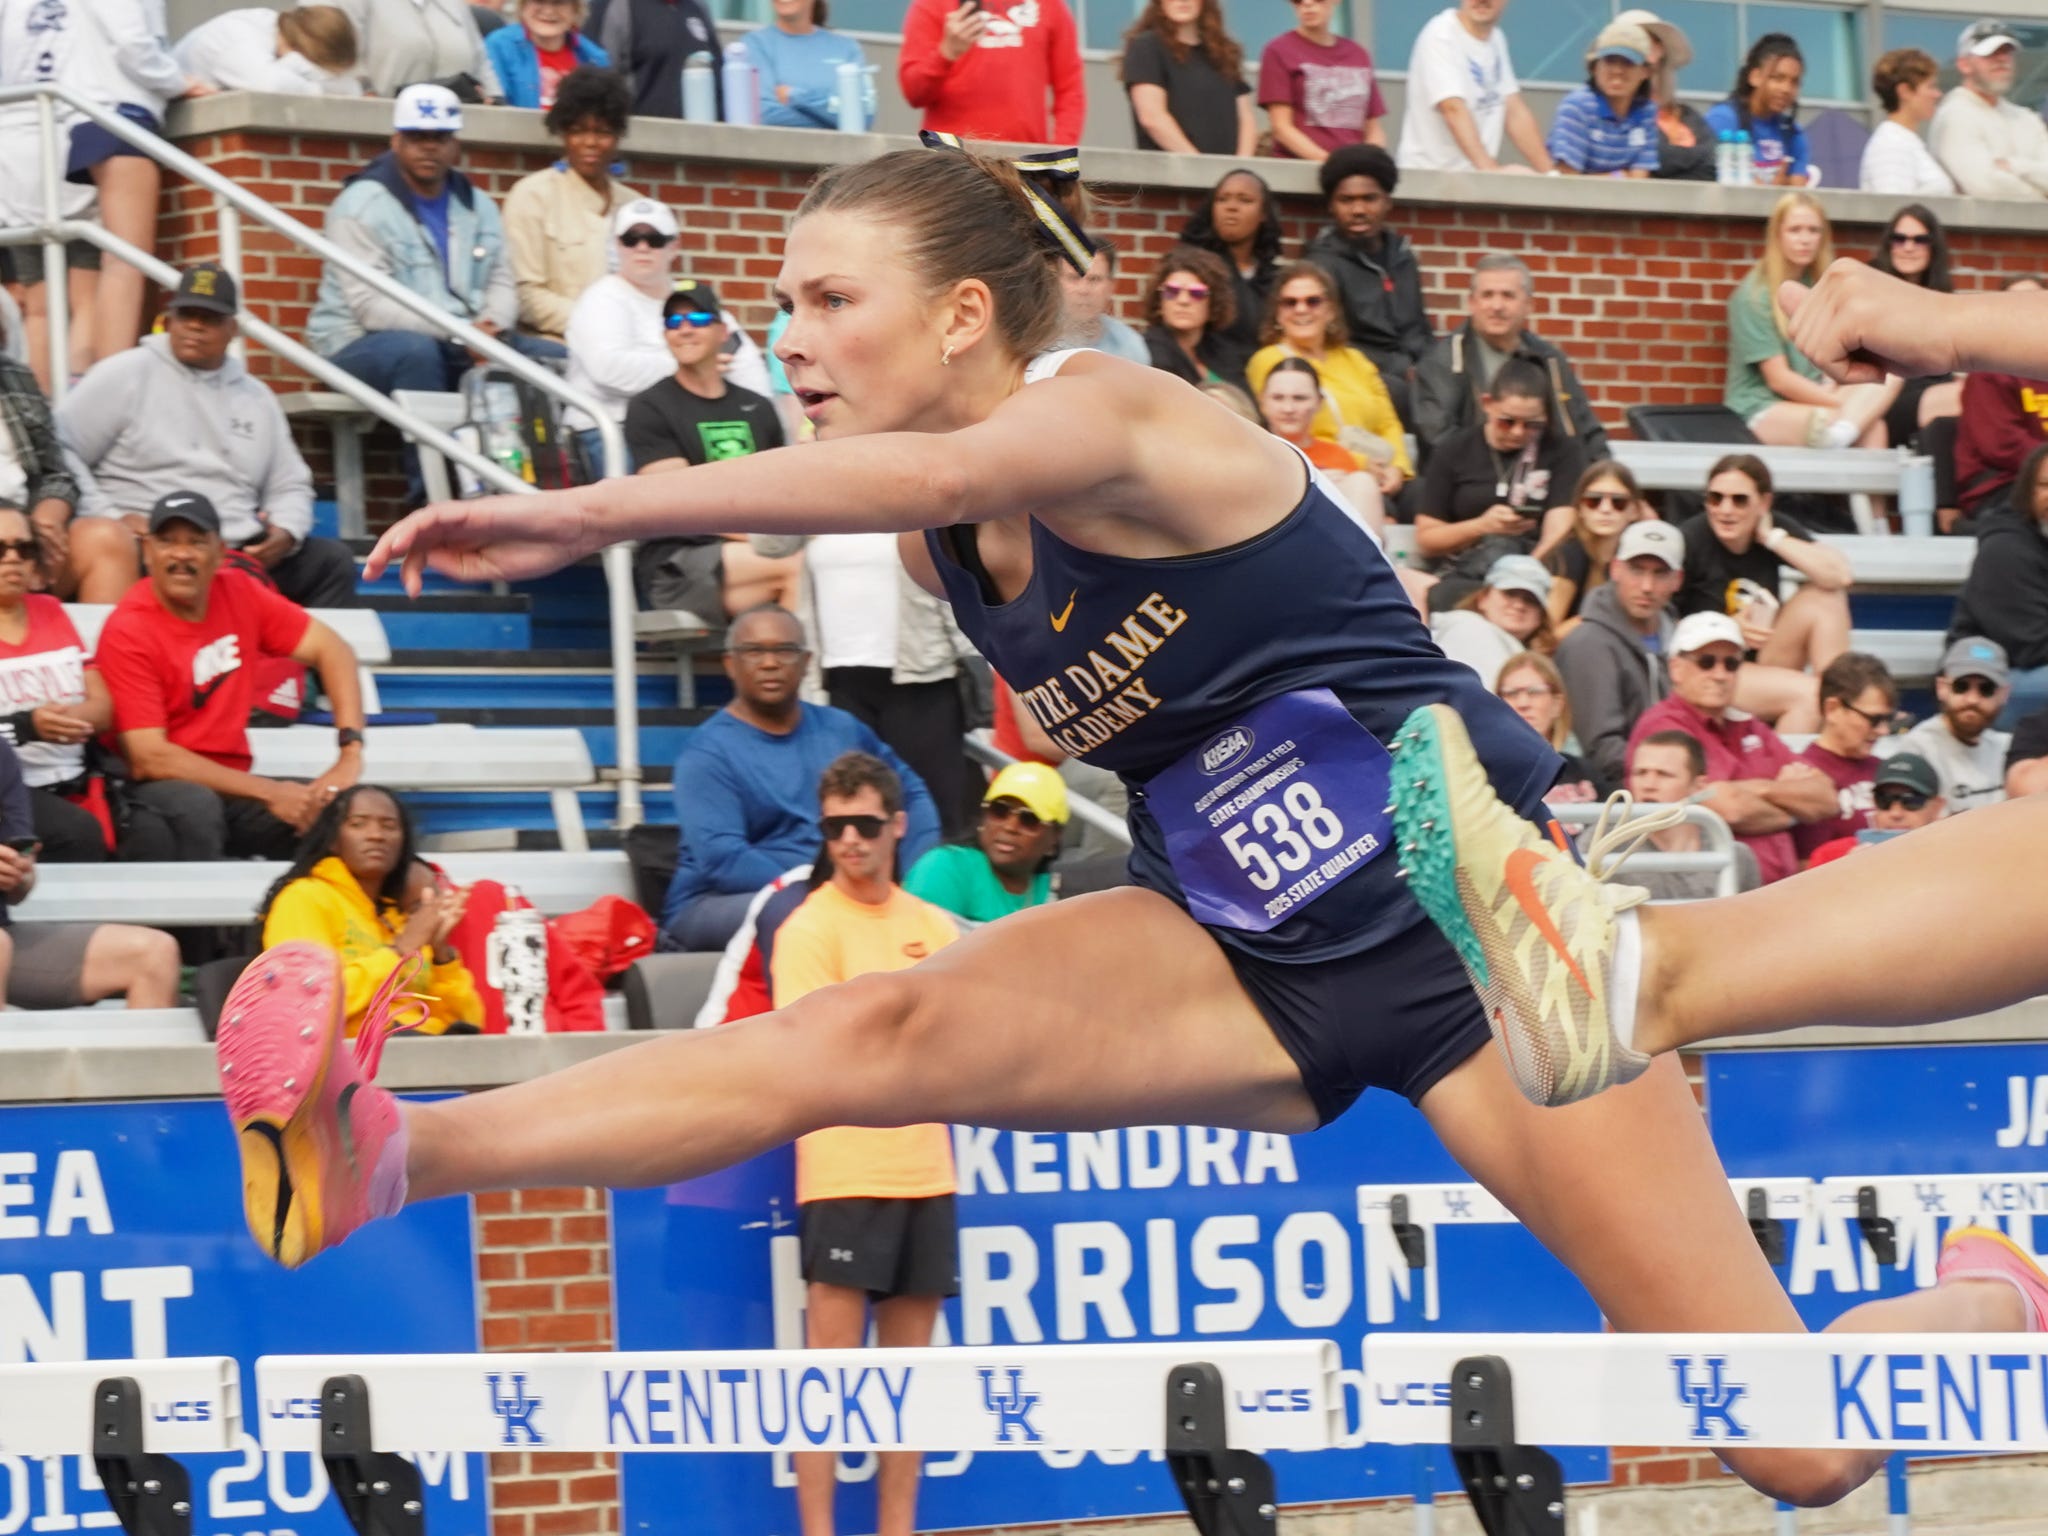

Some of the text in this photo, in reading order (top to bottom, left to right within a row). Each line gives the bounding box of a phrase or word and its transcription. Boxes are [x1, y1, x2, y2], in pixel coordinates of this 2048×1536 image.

[1018, 592, 1189, 729] TRE DAME
[1053, 677, 1162, 758] ACADEMY
[1208, 801, 1239, 828] STATE
[1233, 757, 1305, 810] CHAMPIONSHIPS
[1243, 756, 1272, 776] TRACK
[1272, 740, 1297, 758] FIELD
[1220, 781, 1344, 891] 538
[1264, 833, 1379, 919] 2025 STATE QUALIFIER
[0, 1150, 114, 1239] EA
[952, 1124, 1299, 1195] KENDRA
[770, 1211, 1440, 1350] RRISON
[152, 1400, 211, 1422] UCS
[485, 1366, 1044, 1446] UK KENTUCKY UK
[1235, 1389, 1312, 1412] UCS
[1376, 1383, 1452, 1406] UCS
[1669, 1354, 2048, 1441] UK KENT
